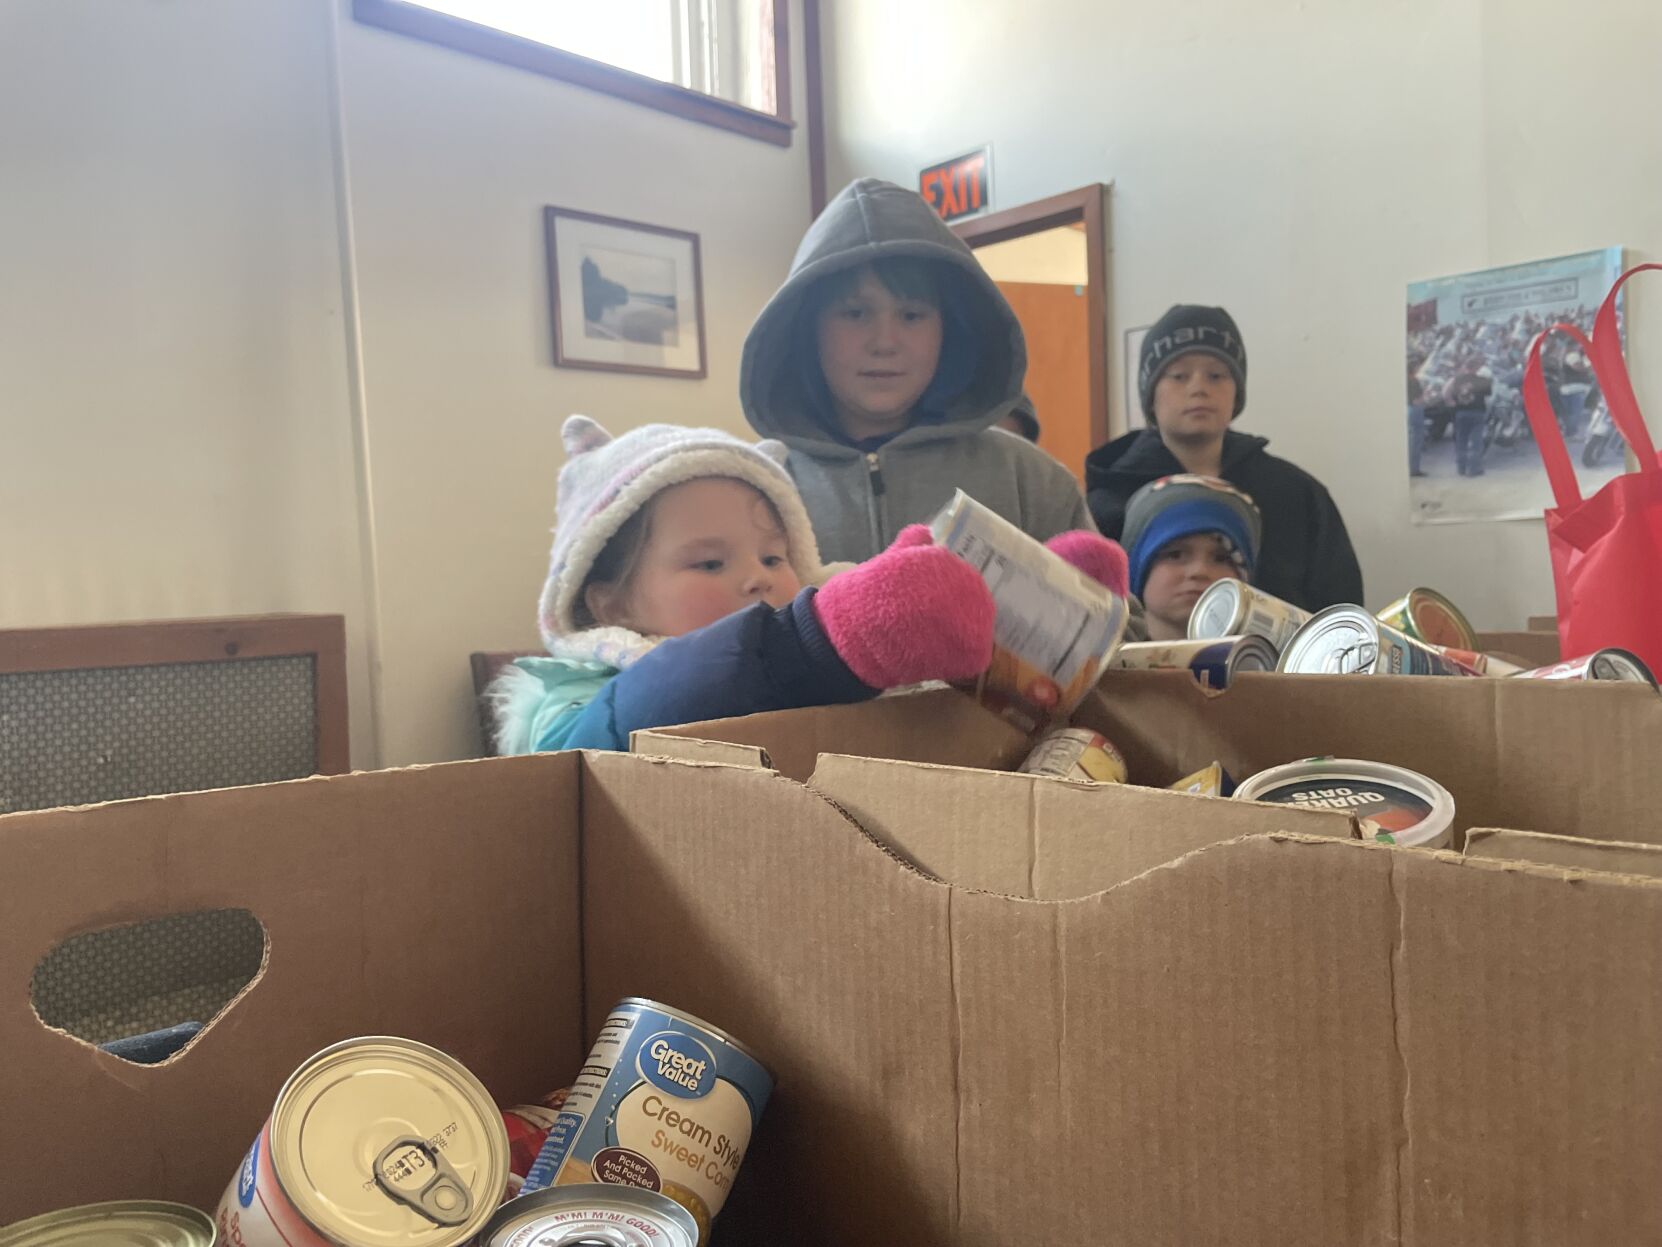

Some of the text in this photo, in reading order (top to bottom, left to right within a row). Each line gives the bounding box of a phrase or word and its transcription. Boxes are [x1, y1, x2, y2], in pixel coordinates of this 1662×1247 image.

[921, 155, 986, 219] EXIT
[1286, 790, 1385, 809] QUAKE
[1292, 787, 1353, 801] OATS
[650, 1039, 707, 1080] Great
[657, 1060, 698, 1092] Value
[642, 1095, 742, 1170] Cream Style
[618, 1154, 648, 1174] Picked
[651, 1129, 706, 1172] Sweet
[603, 1159, 654, 1190] And Packed
[603, 1170, 628, 1186] Same
[626, 1217, 660, 1239] GOOD!
